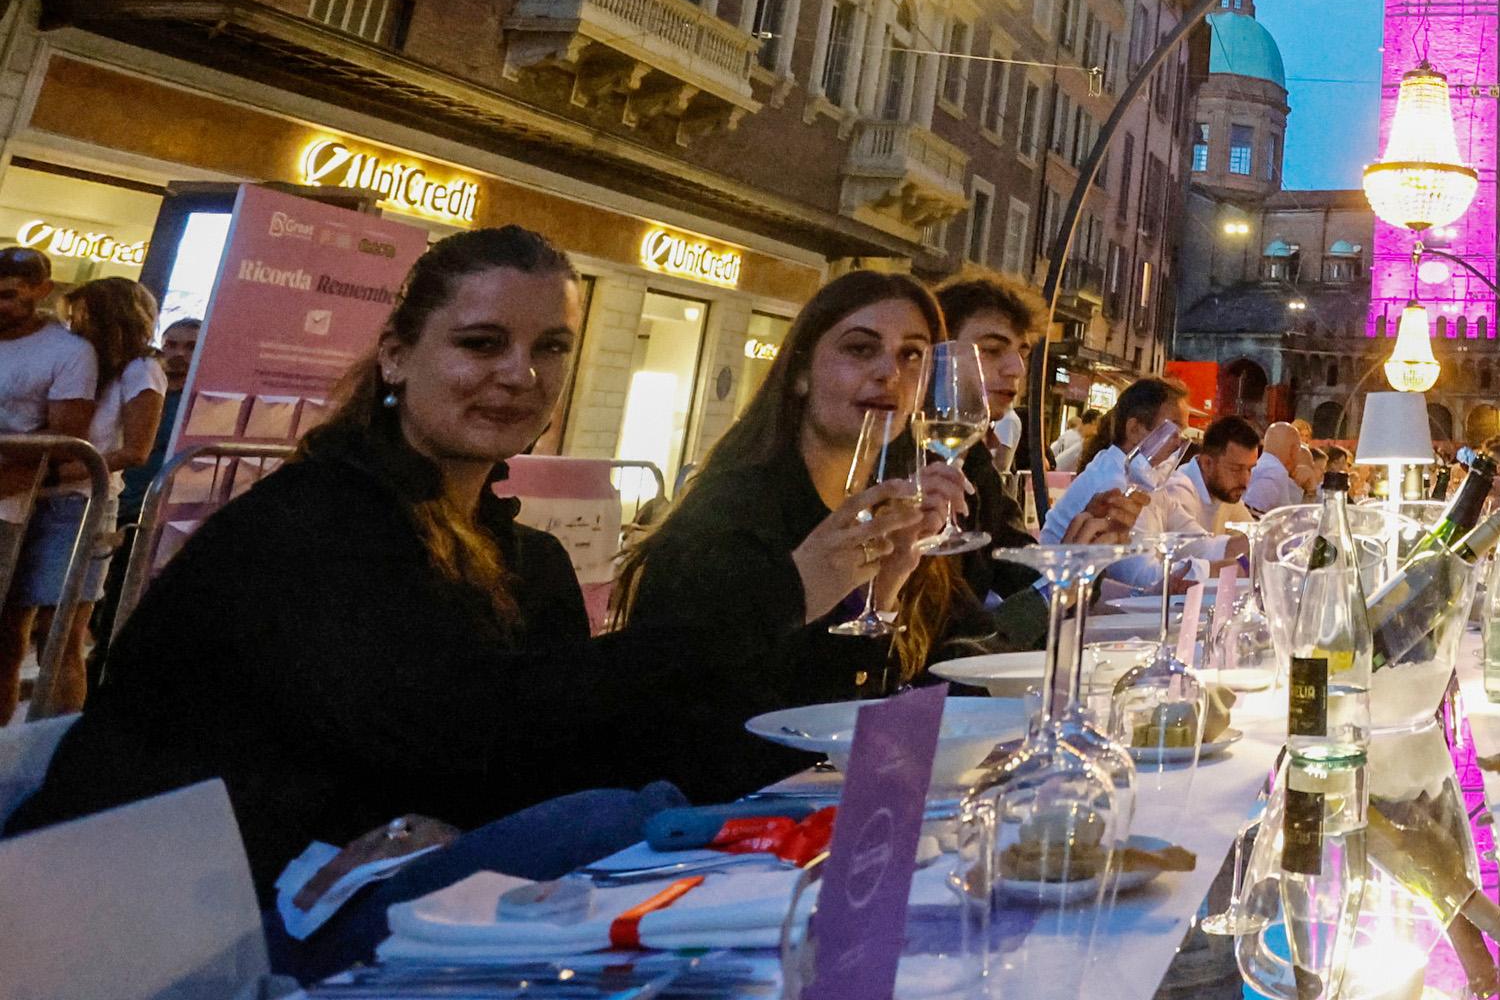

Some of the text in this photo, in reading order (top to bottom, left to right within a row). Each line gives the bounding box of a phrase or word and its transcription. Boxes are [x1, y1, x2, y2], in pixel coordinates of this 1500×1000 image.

[347, 153, 480, 222] UniCredit
[49, 226, 150, 266] UniCred
[669, 238, 741, 283] UniCredit
[238, 258, 312, 291] Ricorda
